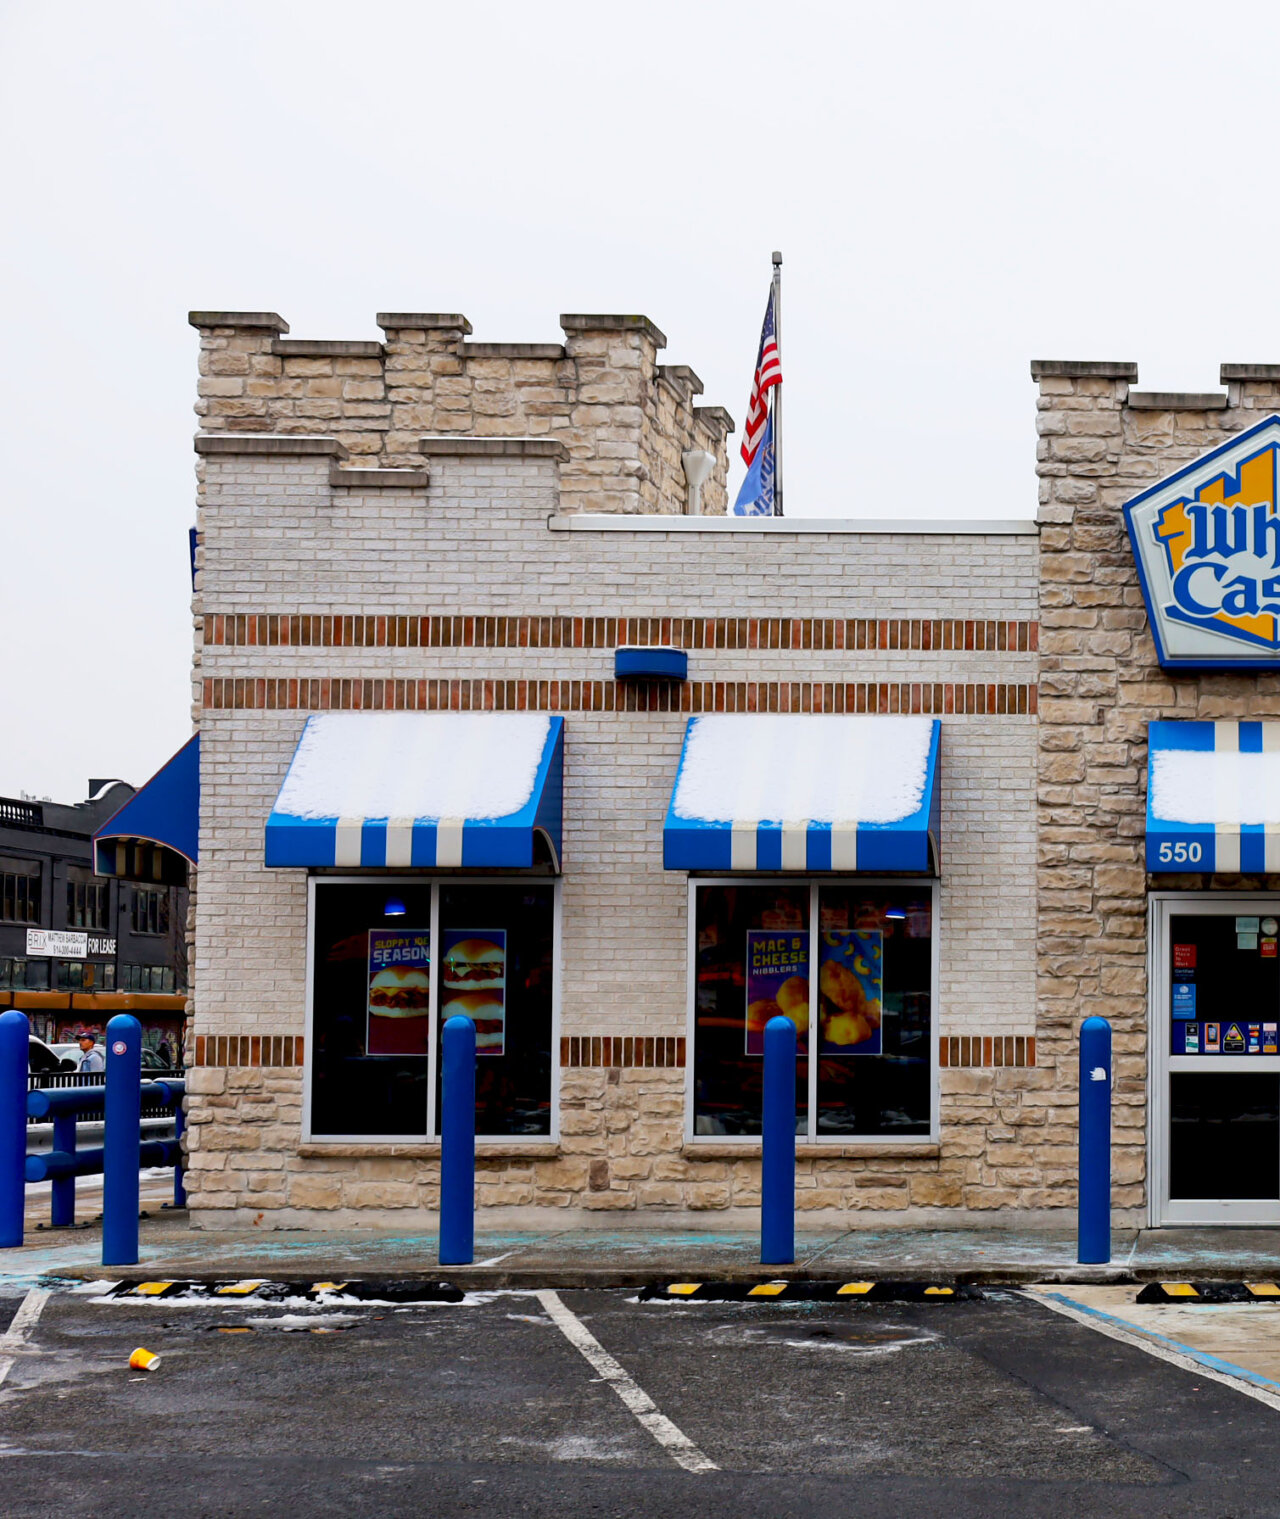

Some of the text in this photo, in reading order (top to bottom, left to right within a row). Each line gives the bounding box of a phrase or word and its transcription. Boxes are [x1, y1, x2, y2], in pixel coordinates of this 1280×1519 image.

[1159, 842, 1202, 863] 550
[28, 933, 47, 947] BRIX
[87, 938, 117, 955] FOR LEASE
[375, 938, 411, 949] SLOPPY
[753, 939, 786, 954] MAC
[373, 946, 431, 963] SEASON
[752, 951, 808, 967] CHEESE
[752, 965, 798, 976] NIBBLERS
